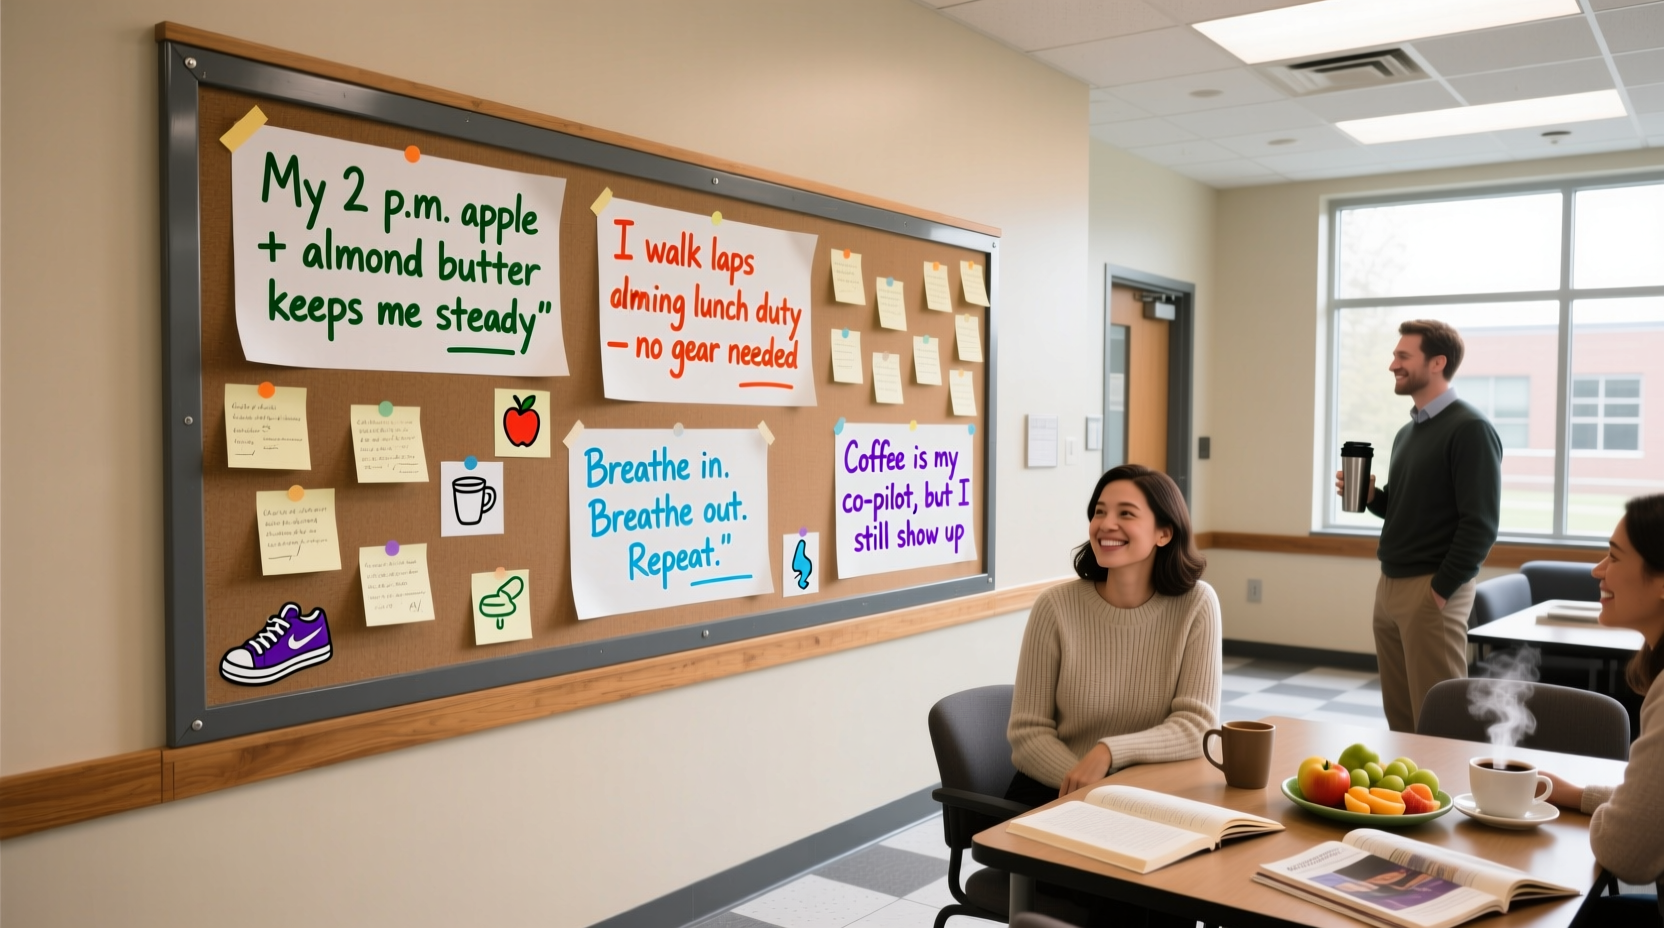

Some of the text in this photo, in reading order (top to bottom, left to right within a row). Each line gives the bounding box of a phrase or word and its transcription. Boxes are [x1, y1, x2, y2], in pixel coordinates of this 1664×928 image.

[262, 152, 538, 245] My 2 p.m. apple
[258, 228, 541, 286] + almond butter
[614, 219, 754, 285] I walk laps
[269, 278, 363, 341] keeps
[378, 301, 422, 328] me
[694, 284, 748, 322] lunch
[756, 291, 802, 341] duty
[636, 336, 662, 359] no
[670, 340, 720, 379] gear
[728, 336, 798, 369] needed
[584, 447, 729, 488] Breathe in.
[844, 440, 959, 480] Coffee is my
[588, 491, 748, 538] Breathe out.
[842, 479, 970, 521] co-pilot, but I
[854, 519, 965, 553] still show up
